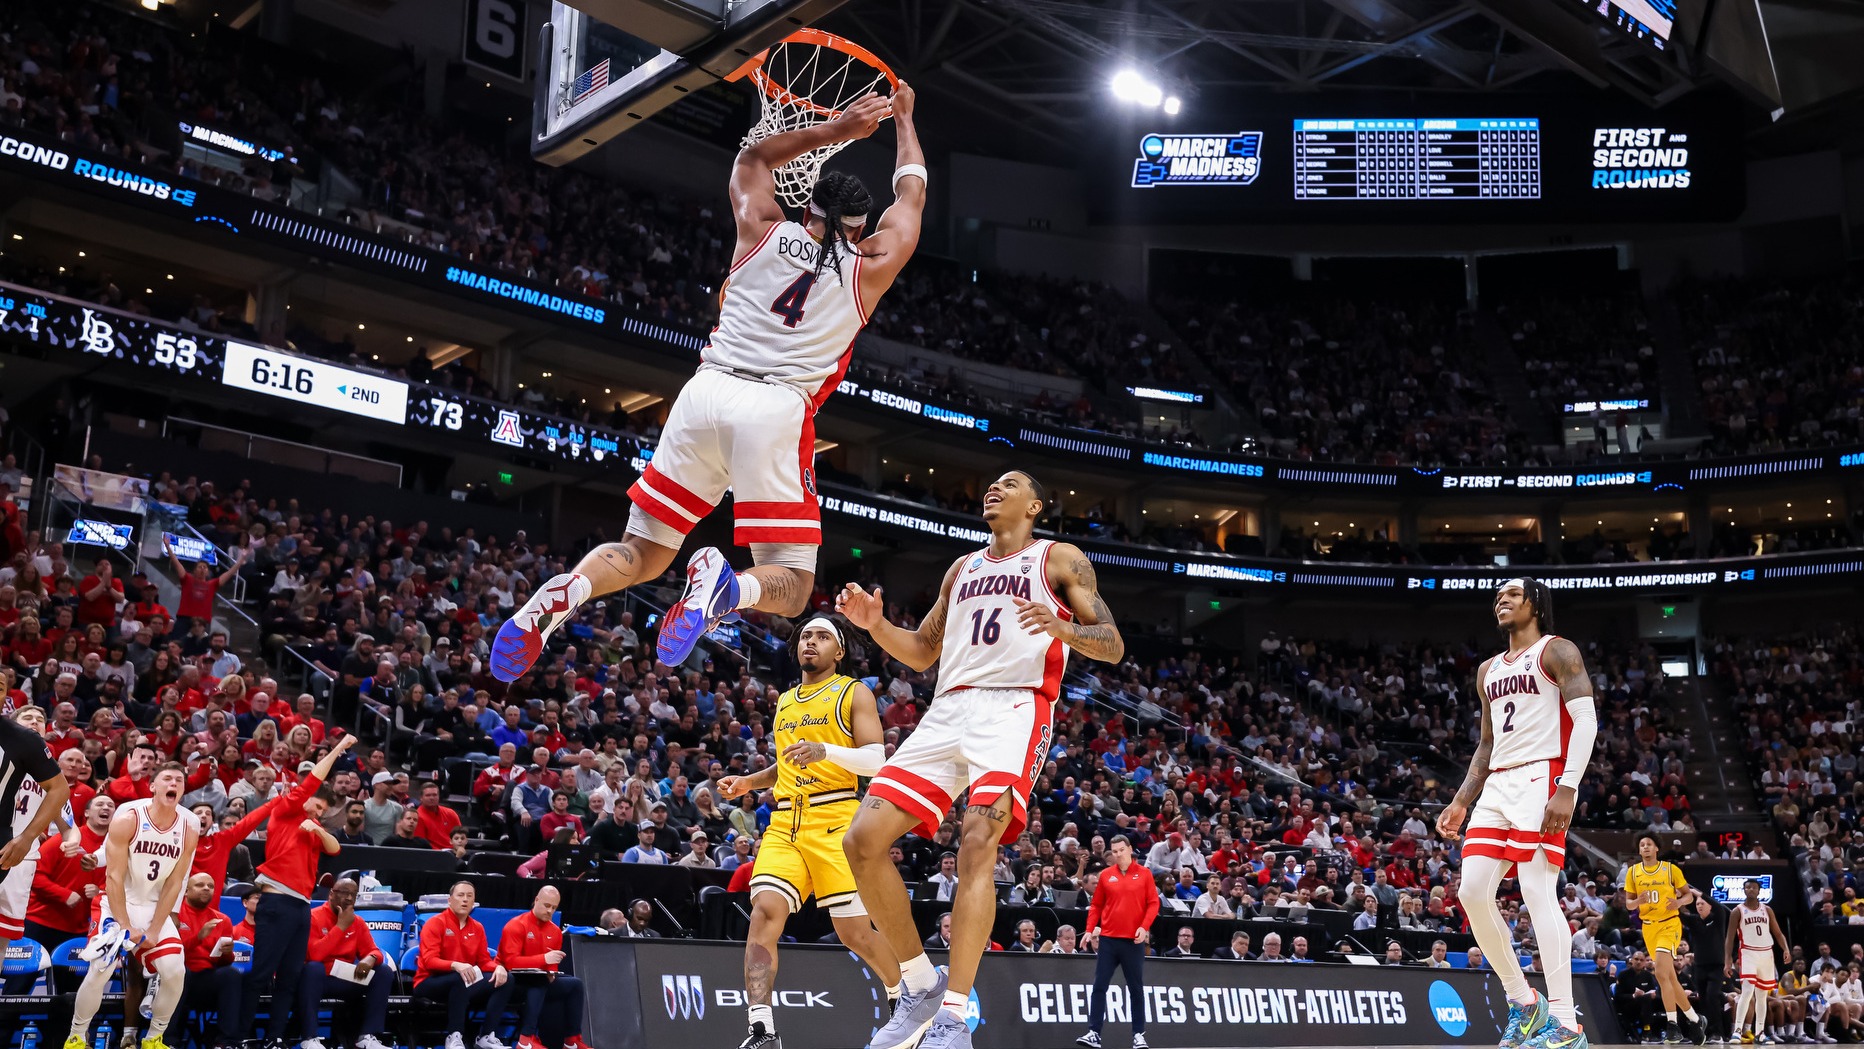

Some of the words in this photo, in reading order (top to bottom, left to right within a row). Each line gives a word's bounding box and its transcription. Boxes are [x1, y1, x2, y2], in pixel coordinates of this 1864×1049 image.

[475, 0, 516, 59] 6
[1593, 128, 1666, 147] FIRST
[1669, 134, 1687, 142] AND
[1162, 138, 1228, 158] MARCH
[0, 135, 69, 171] COND
[74, 158, 171, 200] ROUNDS
[1169, 157, 1258, 177] MADNESS
[1593, 149, 1688, 168] SECOND
[1592, 169, 1691, 189] ROUNDS
[446, 266, 606, 324] #MARCHMADNESS
[770, 270, 805, 329] 4
[26, 303, 47, 319] TOL
[30, 316, 39, 333] 1
[155, 333, 198, 370] 53
[251, 358, 314, 395] 6:16
[351, 387, 380, 405] 2ND
[837, 380, 859, 396] ST
[871, 389, 922, 414] SECOND
[924, 404, 975, 428] ROUNDS
[431, 398, 464, 431] 73
[491, 410, 525, 448] A
[545, 426, 560, 439] TOL
[569, 432, 584, 445] FLS
[591, 437, 618, 452] BONUS
[547, 438, 556, 452] 3
[572, 443, 580, 458] 5
[1143, 452, 1264, 477] #MARCHMADNESS
[1460, 475, 1502, 488] FIRST
[1517, 475, 1573, 488] SECOND
[1576, 472, 1636, 487] ROUNDS
[826, 497, 840, 511] DI
[842, 500, 877, 520] MEN'S
[878, 509, 946, 536] BASKETBALL
[948, 526, 993, 545] CHAMPI
[1186, 563, 1273, 582] MARCHMADNESS
[1442, 578, 1475, 590] 2024
[1477, 578, 1493, 590] DI
[1615, 572, 1717, 587] CHAMPIONSHIP
[957, 575, 1032, 605] ARIZONA
[971, 607, 1003, 646] 16
[1486, 674, 1541, 704] ARIZONA
[777, 715, 798, 733] Long
[800, 713, 829, 728] Beach
[1502, 701, 1516, 733] 2
[19, 779, 43, 798] ONA
[133, 840, 181, 860] ARIZONA
[147, 860, 160, 881] 3
[1756, 925, 1763, 936] 0
[5, 951, 32, 959] MADNESS
[715, 989, 834, 1007] BICK
[1192, 986, 1407, 1024] STUDENT-ATHLETES
[1436, 1007, 1467, 1022] NCAA
